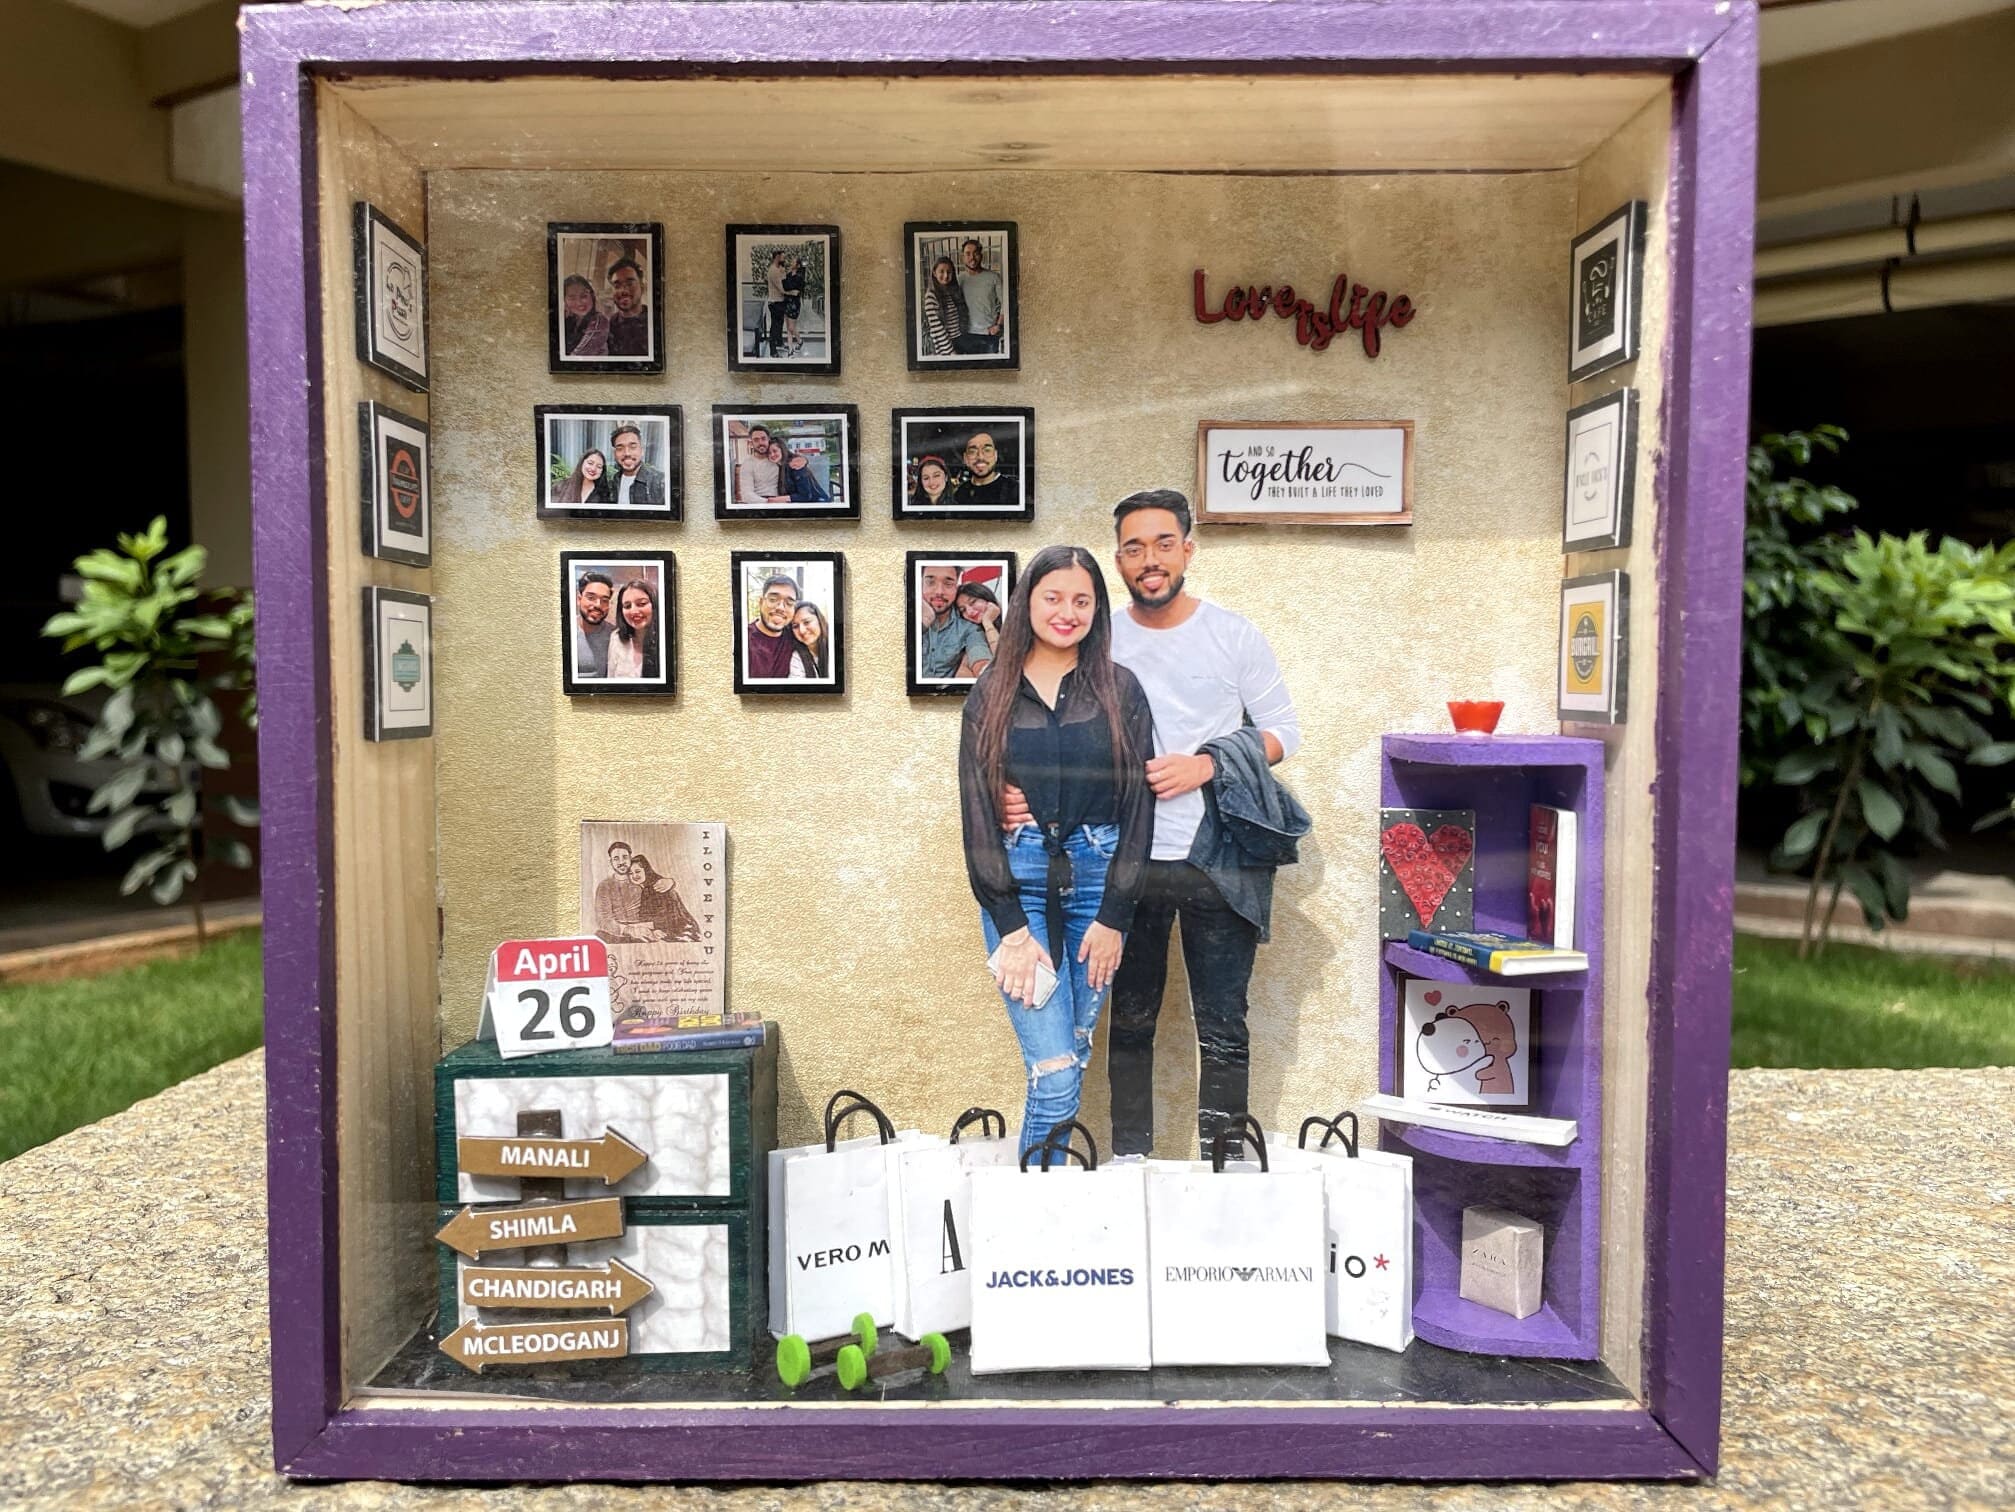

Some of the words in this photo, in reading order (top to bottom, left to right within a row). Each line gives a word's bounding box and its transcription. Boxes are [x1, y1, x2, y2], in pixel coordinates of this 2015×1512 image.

[1194, 269, 1296, 324] Love
[1296, 299, 1334, 350] is
[1329, 273, 1416, 358] life
[1248, 446, 1262, 457] AND
[1266, 446, 1275, 457] SO
[1217, 445, 1392, 500] together
[1268, 486, 1285, 498] THEY
[1288, 486, 1309, 498] BUILT
[1312, 486, 1318, 498] A
[1321, 486, 1337, 498] LIFE
[1340, 486, 1358, 498] THEY
[1361, 485, 1384, 498] LOVED
[703, 846, 715, 903] LOVE
[703, 914, 715, 955] YOU
[513, 944, 591, 980] April
[517, 986, 596, 1041] 26
[501, 1146, 590, 1168] MANALI
[490, 1214, 577, 1239] SHIMLA
[940, 1199, 967, 1275] A
[797, 1244, 862, 1271] VERO
[985, 1267, 1134, 1289] JACK&JONES
[1165, 1266, 1234, 1282] EMPORIO
[1254, 1266, 1313, 1282] ARMANI
[468, 1278, 622, 1299] CHANDIGARH
[464, 1329, 620, 1356] MCLEODGANJ
